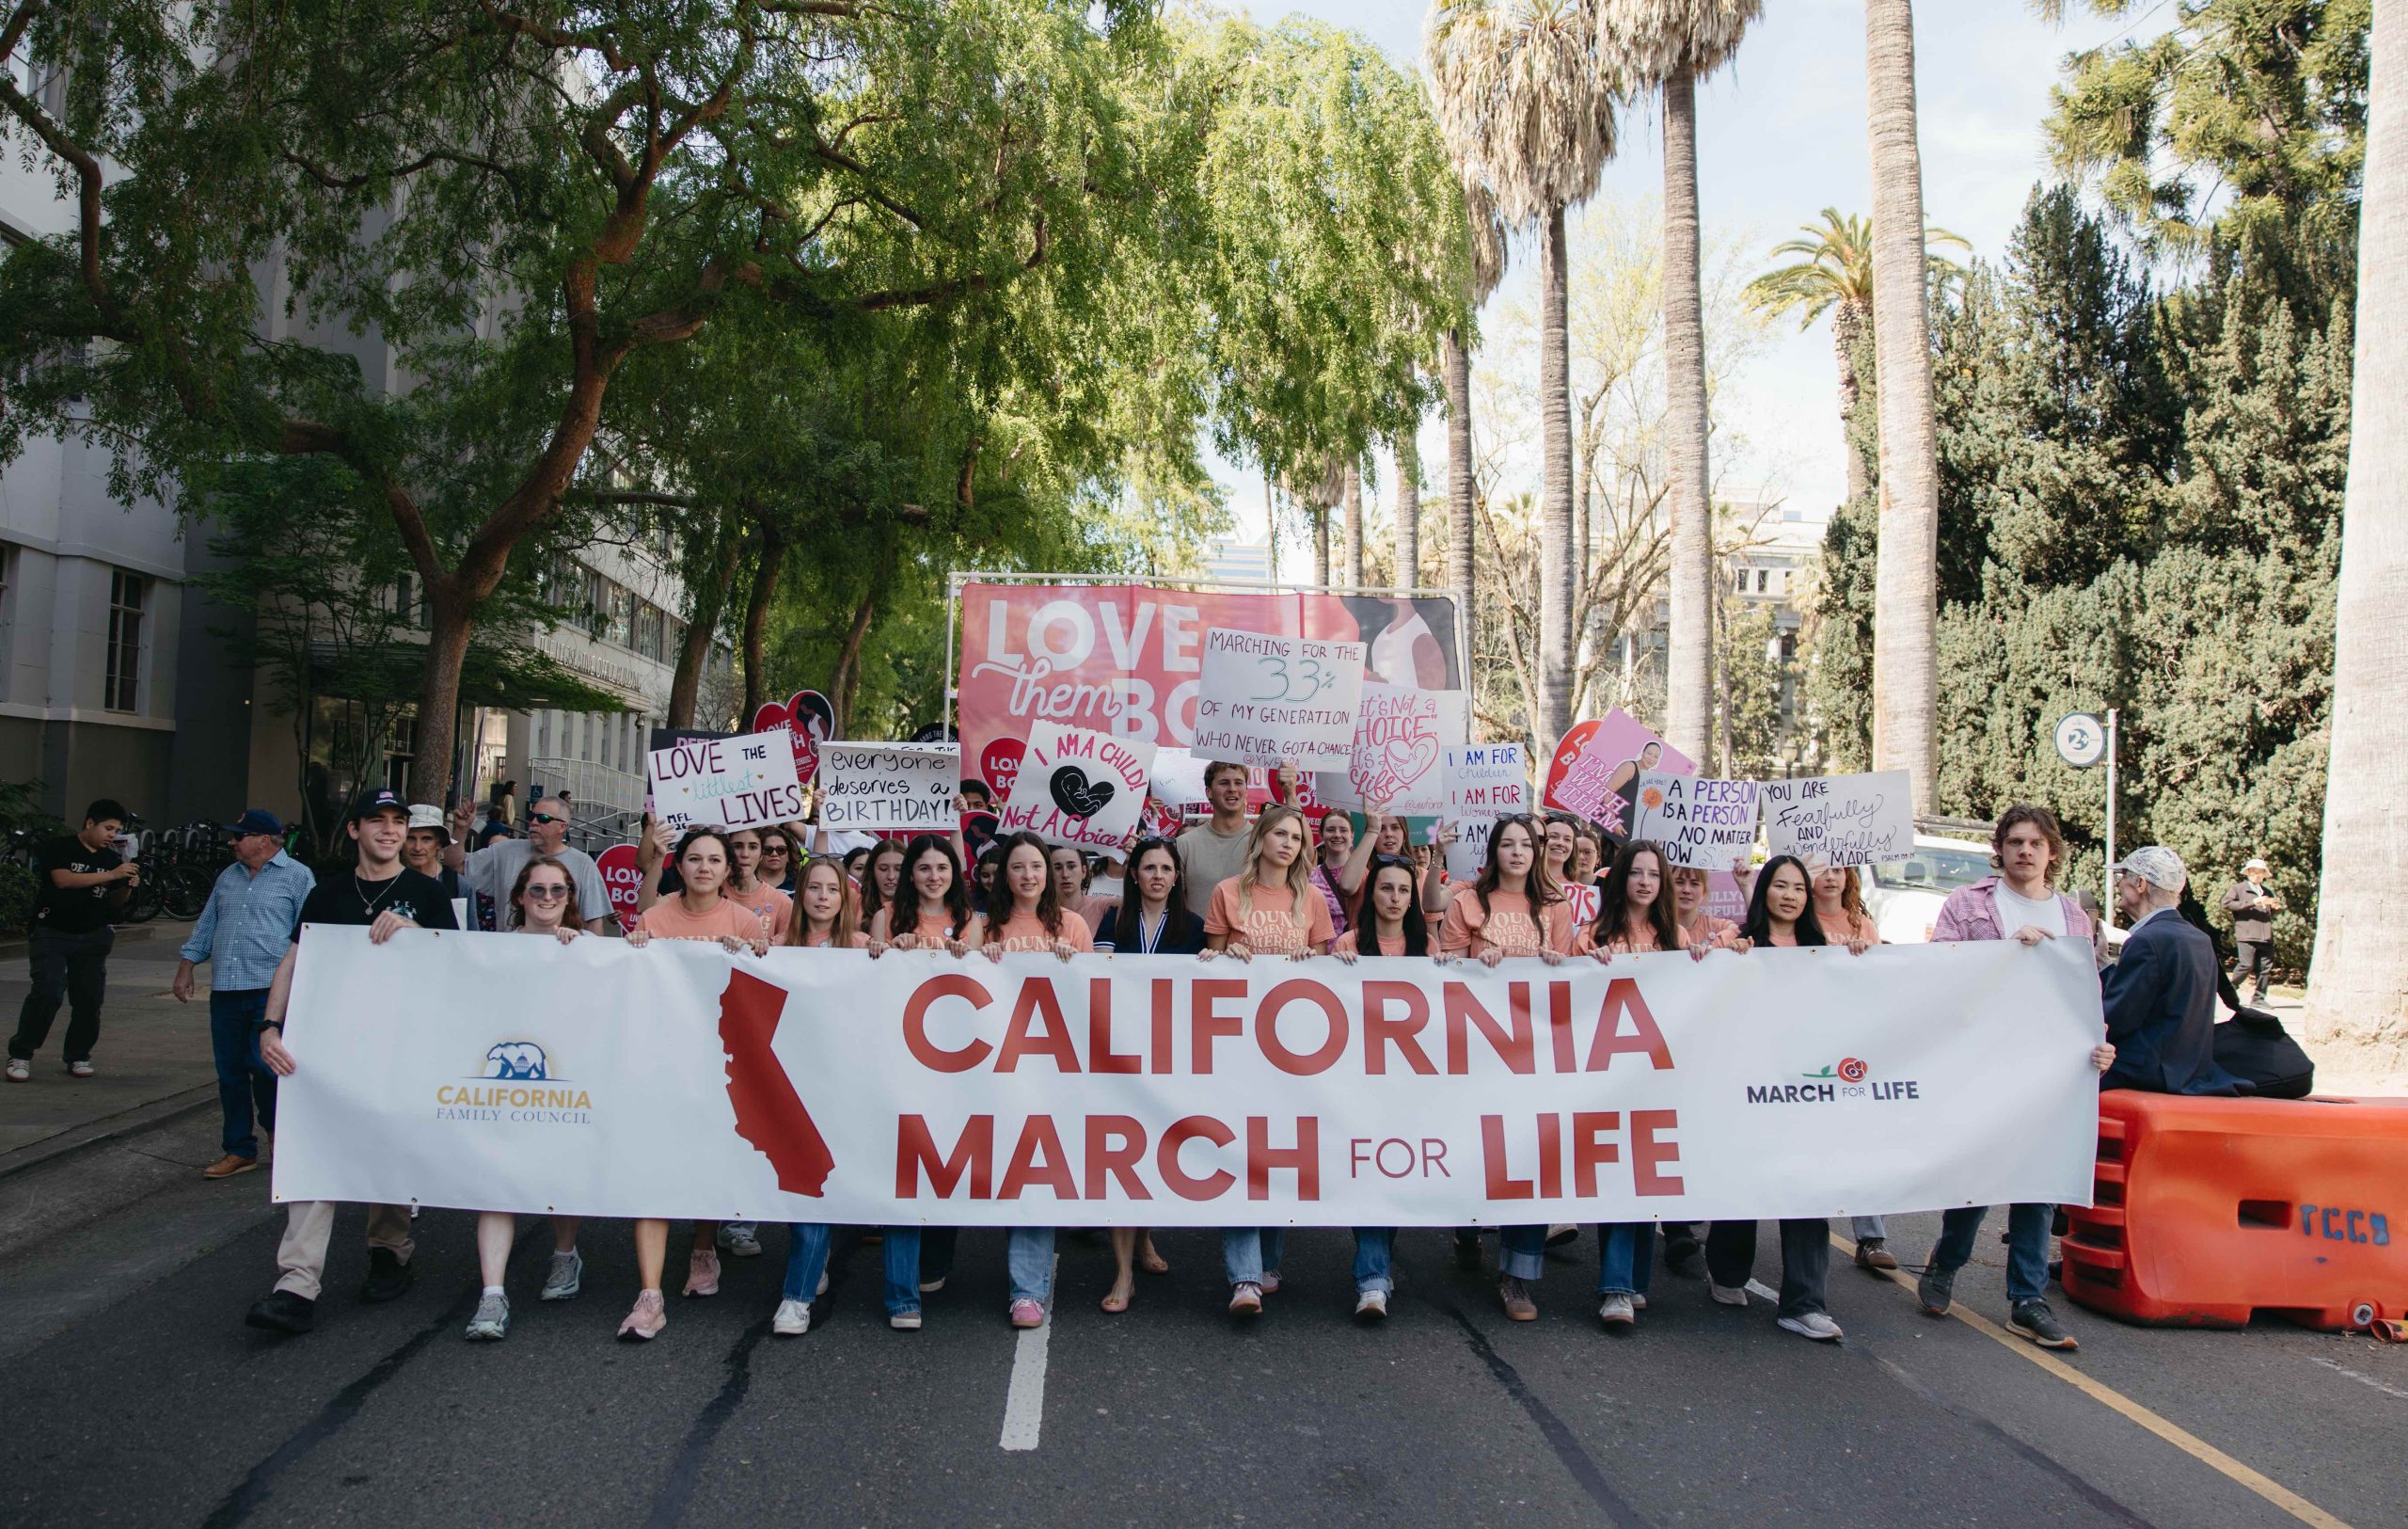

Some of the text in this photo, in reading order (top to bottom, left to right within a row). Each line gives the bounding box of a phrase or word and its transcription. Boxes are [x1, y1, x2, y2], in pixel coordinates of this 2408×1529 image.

[989, 600, 1200, 672] LOVE
[1210, 631, 1360, 661] MARCHING FOR THE
[972, 657, 1122, 718] them
[1250, 657, 1337, 702] 33%
[1200, 699, 1350, 725] OF MY GENERATION
[1424, 698, 1436, 713] a
[1196, 727, 1230, 749] WHO
[1235, 734, 1277, 754] NEVER
[1317, 741, 1353, 756] CHANCE
[655, 741, 725, 781] LOVE
[741, 745, 767, 760] THE
[832, 752, 945, 772] everyone
[1035, 733, 1148, 792] I AM A CHILD!
[1449, 747, 1517, 767] I AM FOR
[692, 768, 753, 802] littlest
[829, 775, 950, 796] deserves a
[1452, 784, 1520, 805] I AM FOR
[1571, 770, 1631, 814] WITH
[1668, 779, 1682, 798] A
[1694, 780, 1757, 804] PERSON
[1801, 781, 1829, 800] ARE
[667, 812, 692, 824] MFL
[721, 785, 801, 825] LIVES
[826, 799, 951, 822] BIRTHDAY!
[1561, 785, 1625, 834] THEM
[1662, 802, 1749, 826] IS A PERSON
[1776, 793, 1883, 831] Fearfully
[1002, 804, 1134, 850] Not A Choice!
[1465, 824, 1488, 843] AM
[1678, 825, 1751, 845] NO MATTER
[1798, 825, 1824, 841] AND
[1783, 825, 1896, 857] wonderfully
[902, 974, 1674, 1075] CALIFORNIA
[436, 1085, 593, 1109] CALIFORNIA
[1747, 1080, 1920, 1104] MARCH FOR LIFE
[436, 1107, 591, 1124] FAMILY COUNCIL
[895, 1109, 1685, 1202] MARCH FOR LIFE
